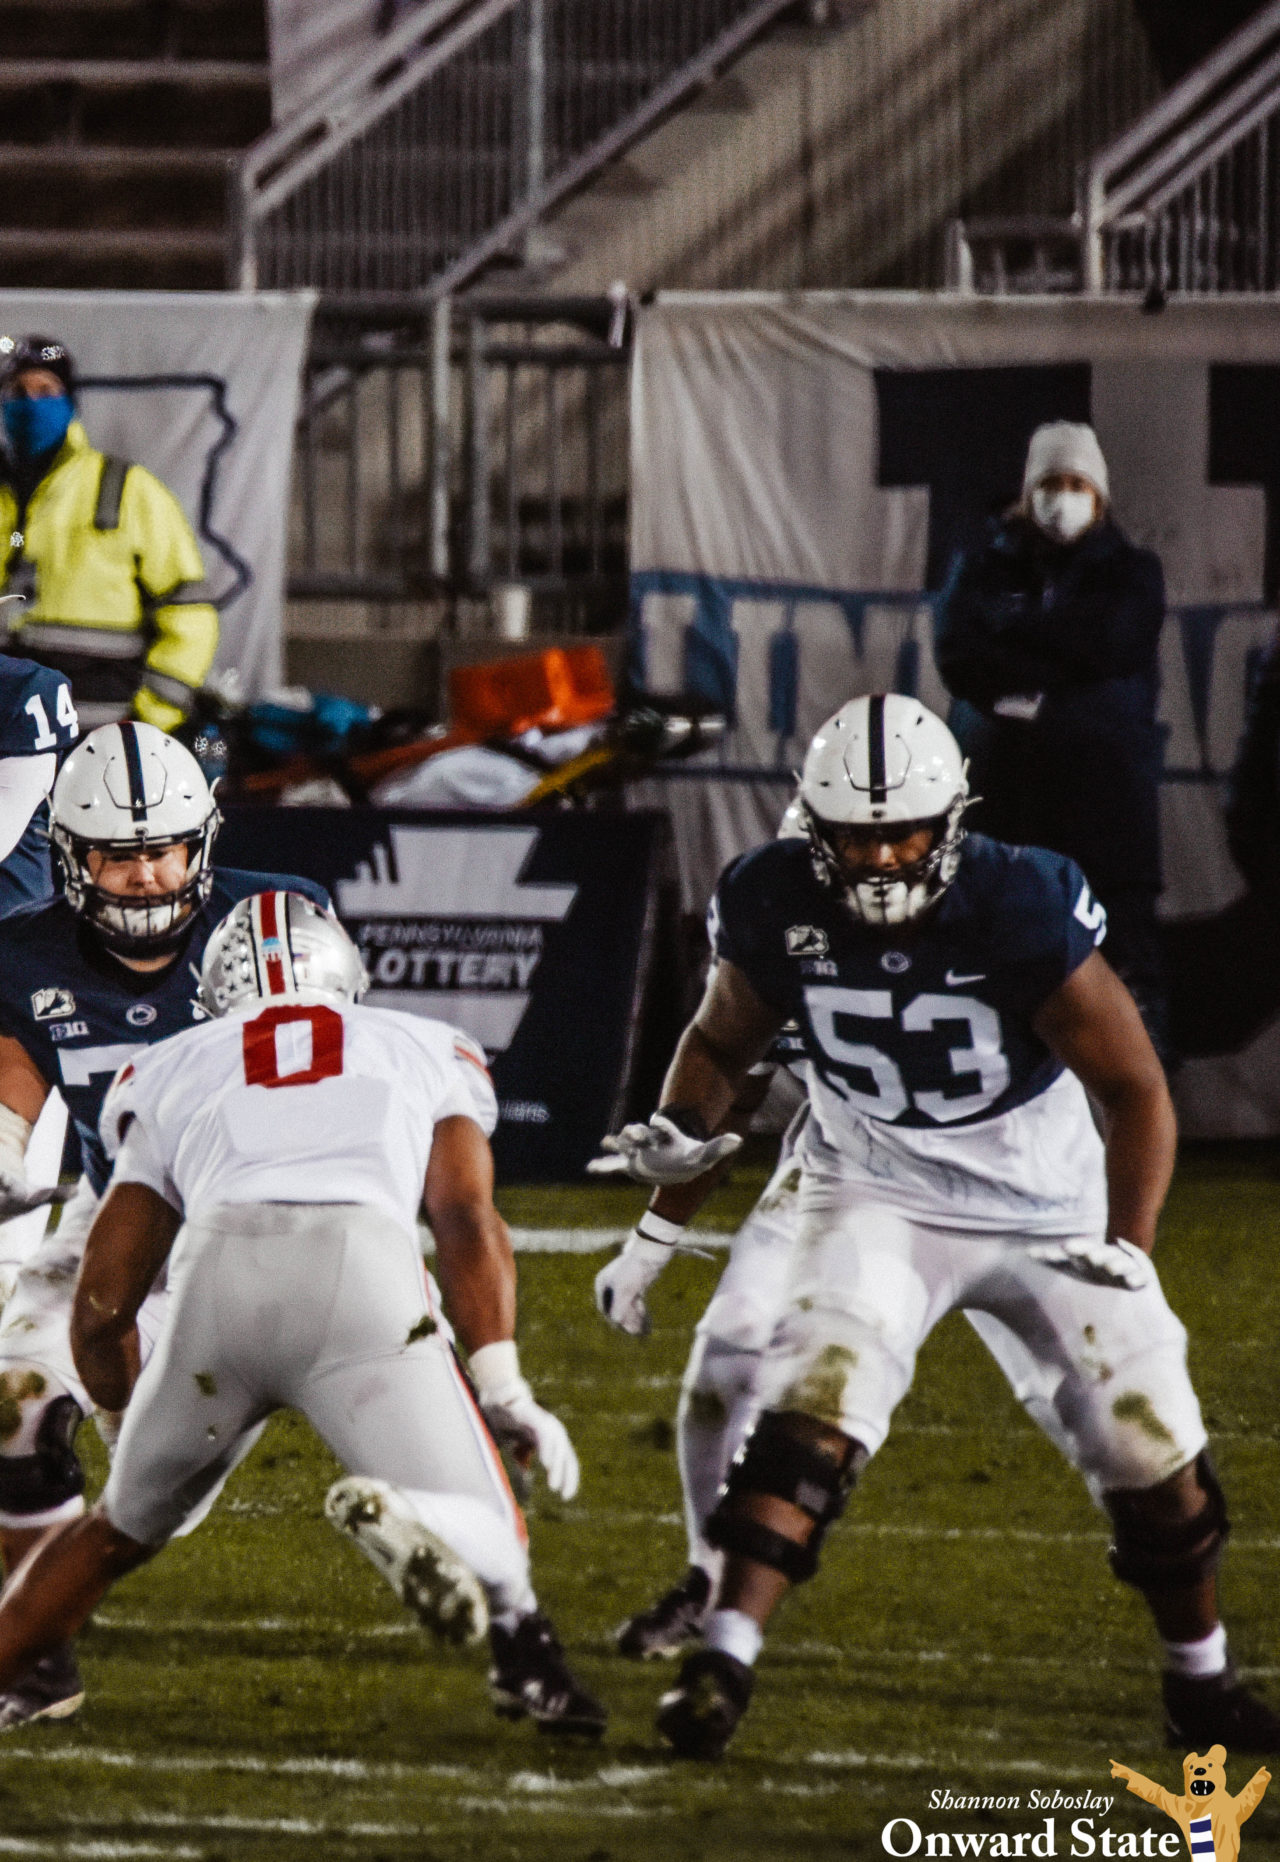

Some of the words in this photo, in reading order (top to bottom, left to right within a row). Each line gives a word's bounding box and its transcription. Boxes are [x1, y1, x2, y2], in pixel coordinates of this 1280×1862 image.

[25, 683, 79, 751] 14
[242, 1004, 345, 1089] 0
[803, 985, 1011, 1124] 53
